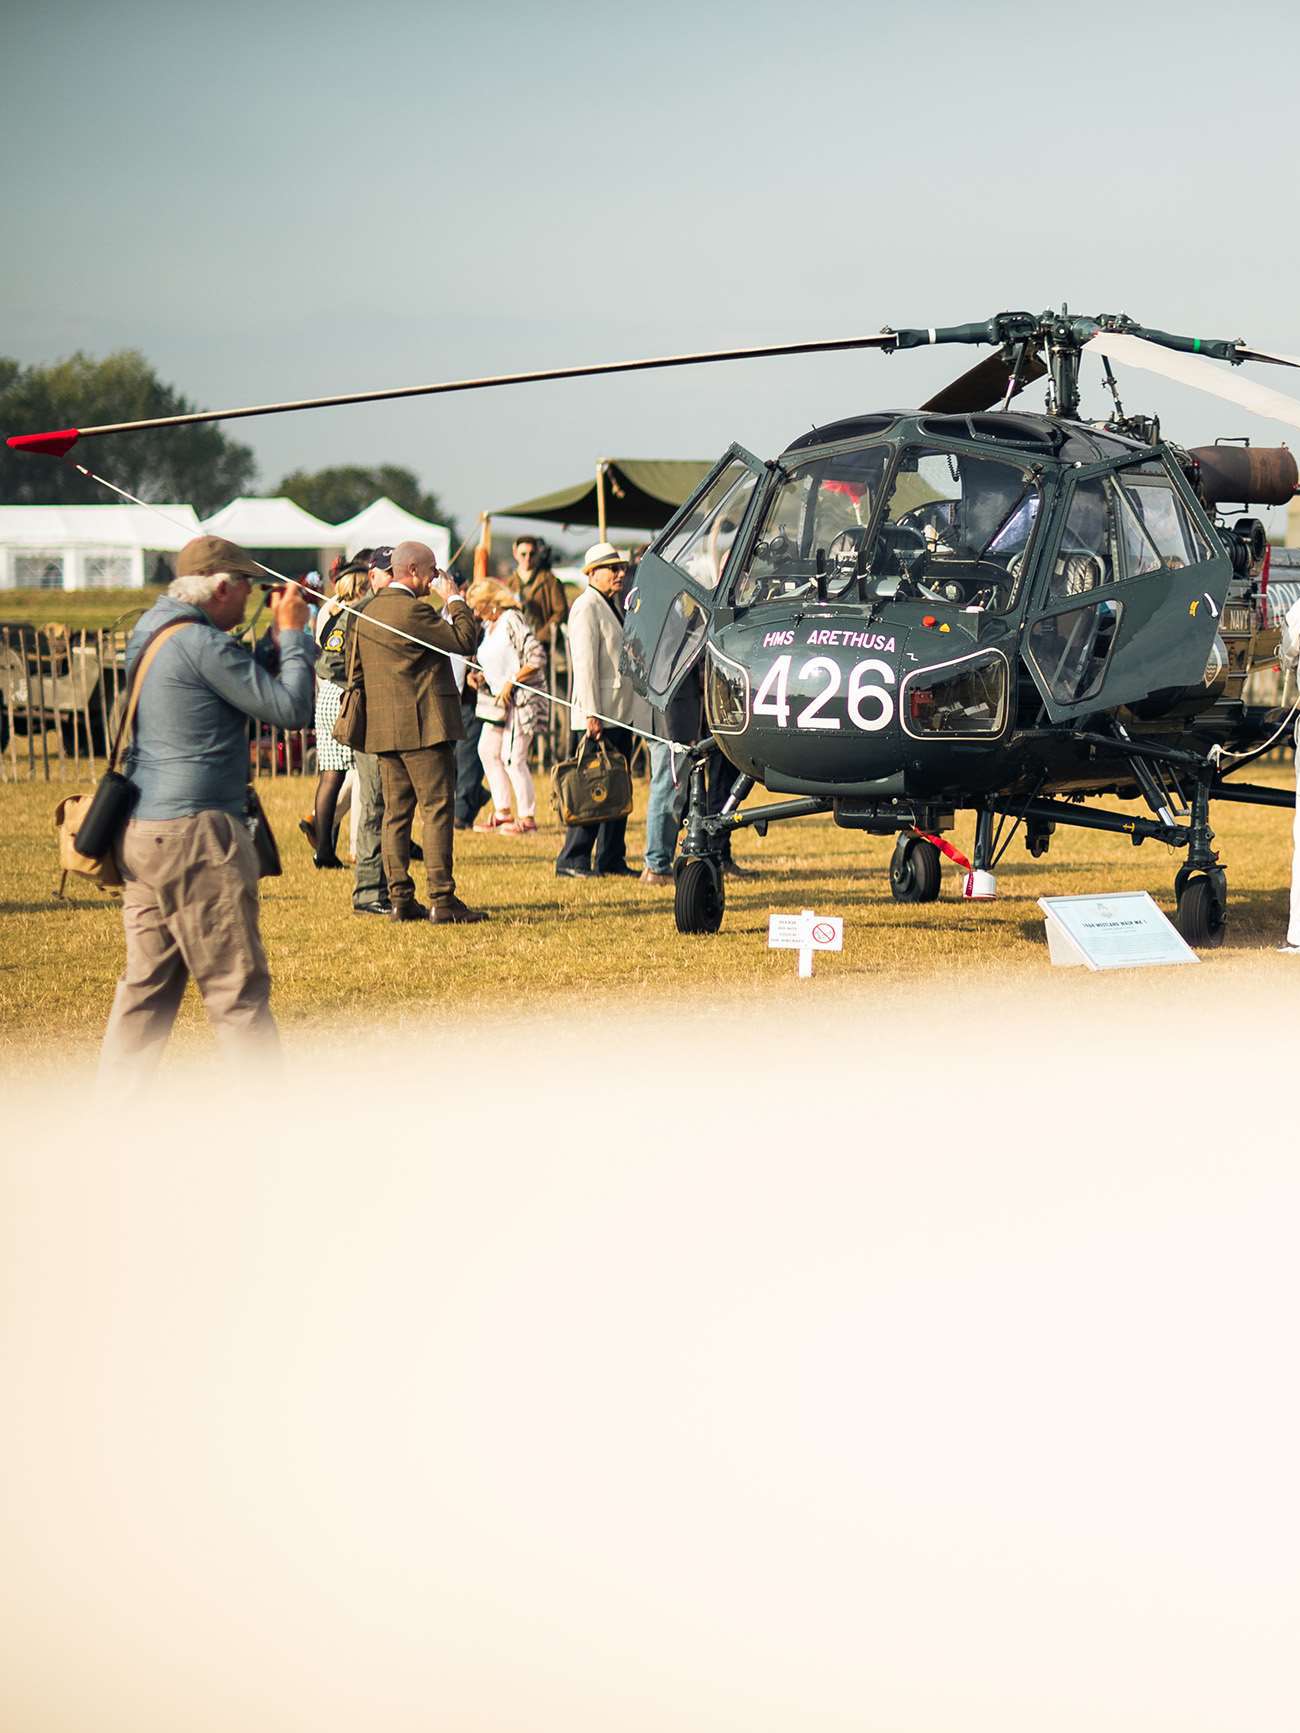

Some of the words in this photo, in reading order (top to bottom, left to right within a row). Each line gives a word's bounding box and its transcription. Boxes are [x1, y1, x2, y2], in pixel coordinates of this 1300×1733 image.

[763, 630, 795, 648] HMS
[806, 629, 896, 653] ARETHUSA
[752, 655, 896, 732] 426
